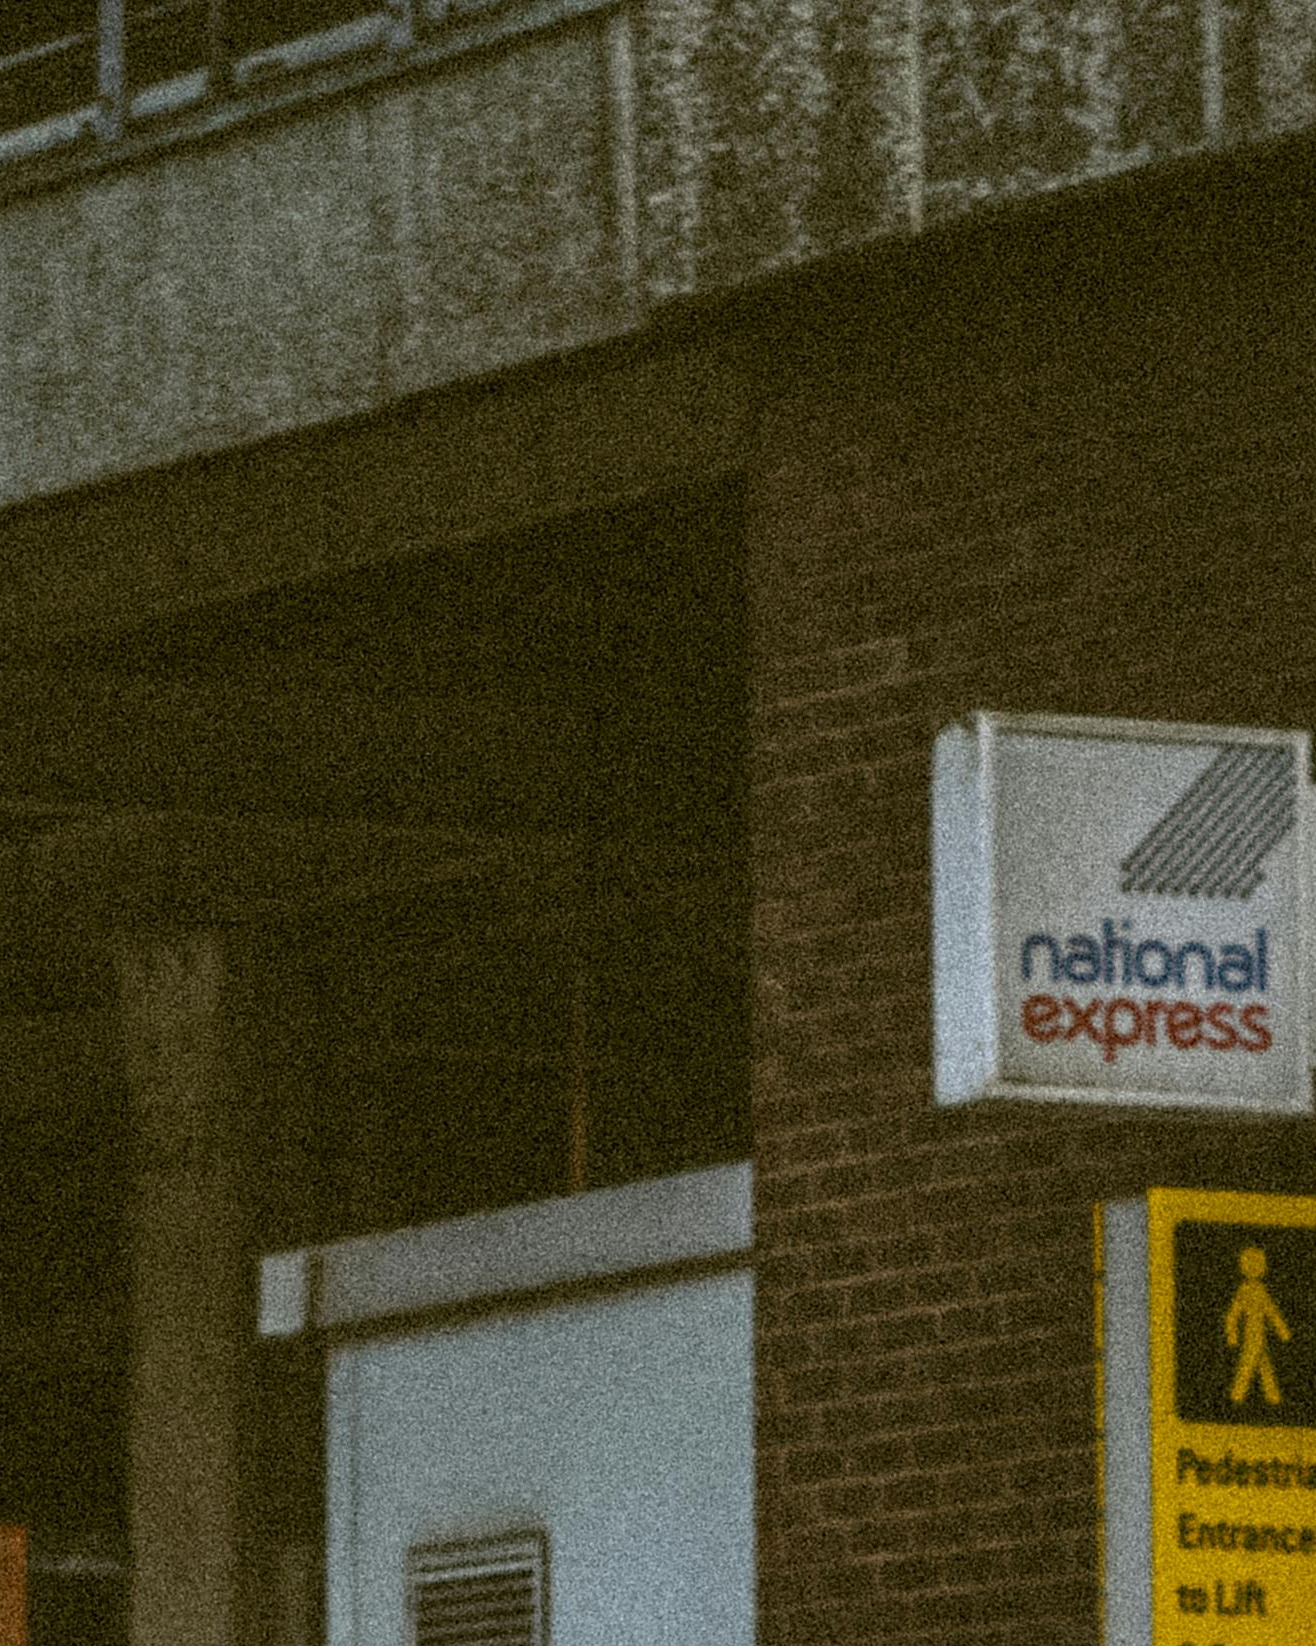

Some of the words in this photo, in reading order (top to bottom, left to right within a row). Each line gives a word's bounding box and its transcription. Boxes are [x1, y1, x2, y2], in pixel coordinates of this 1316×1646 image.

[1020, 917, 1268, 993] national
[1021, 993, 1273, 1064] express
[1178, 1513, 1316, 1555] Entrance
[1177, 1585, 1208, 1615] to
[1215, 1579, 1267, 1617] Lift
